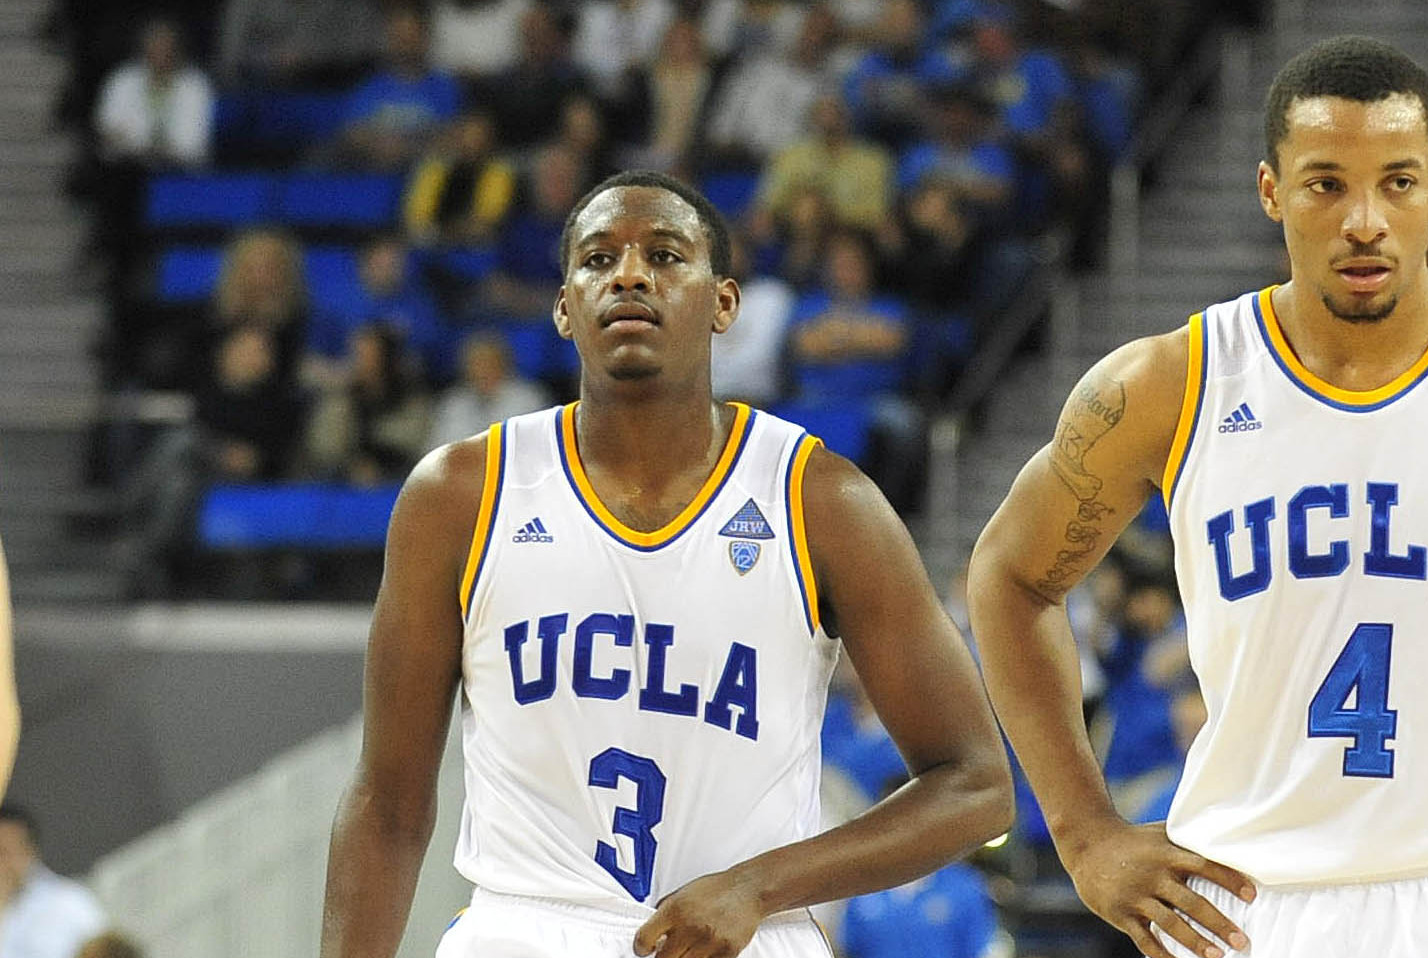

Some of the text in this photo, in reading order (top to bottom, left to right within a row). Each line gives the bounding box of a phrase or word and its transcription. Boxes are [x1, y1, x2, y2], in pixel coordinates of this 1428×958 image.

[1217, 420, 1263, 434] adidas
[512, 531, 554, 543] adidas
[729, 520, 765, 534] JRW
[504, 612, 761, 742] UCLA
[1307, 622, 1398, 779] 4
[588, 747, 667, 903] 3
